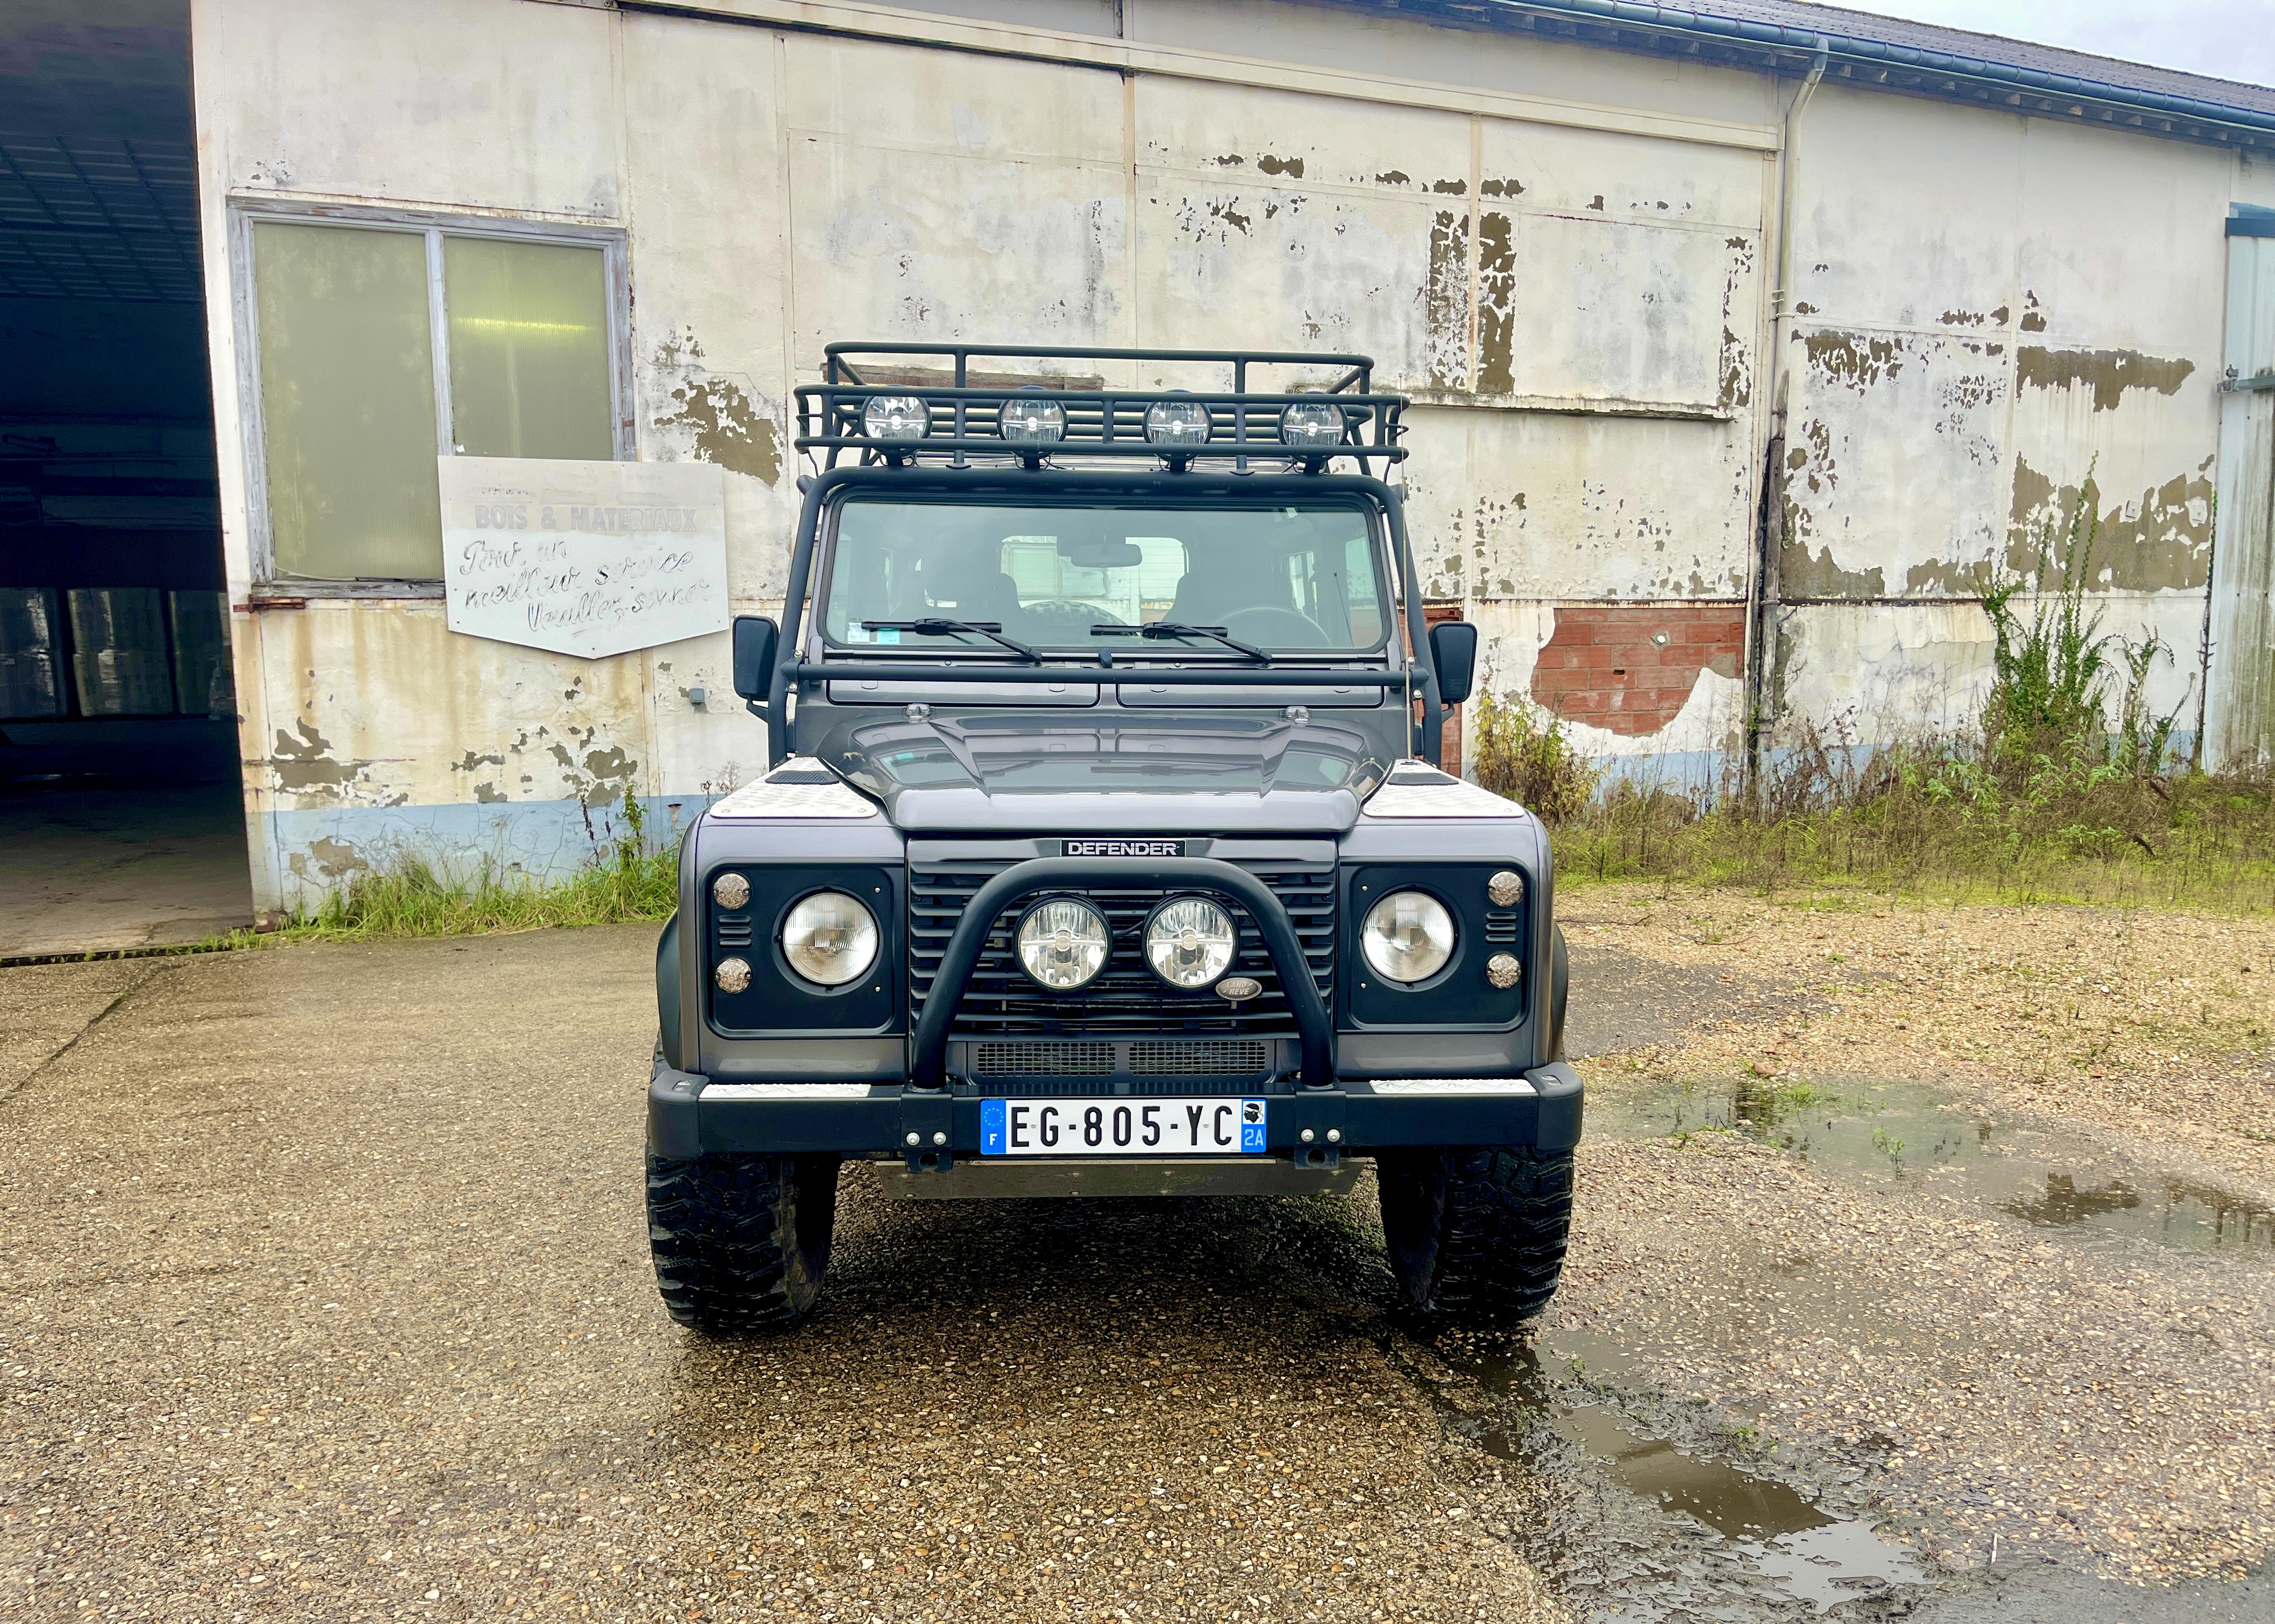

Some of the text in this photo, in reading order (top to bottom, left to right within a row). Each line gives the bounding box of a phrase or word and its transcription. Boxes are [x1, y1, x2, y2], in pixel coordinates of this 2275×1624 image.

[474, 504, 698, 532] BOIS & MATERIAUX
[1068, 842, 1177, 855] DEFENDER
[1010, 1105, 1232, 1147] EG-805-YC
[989, 1133, 997, 1146] F
[1244, 1129, 1263, 1146] 2A
